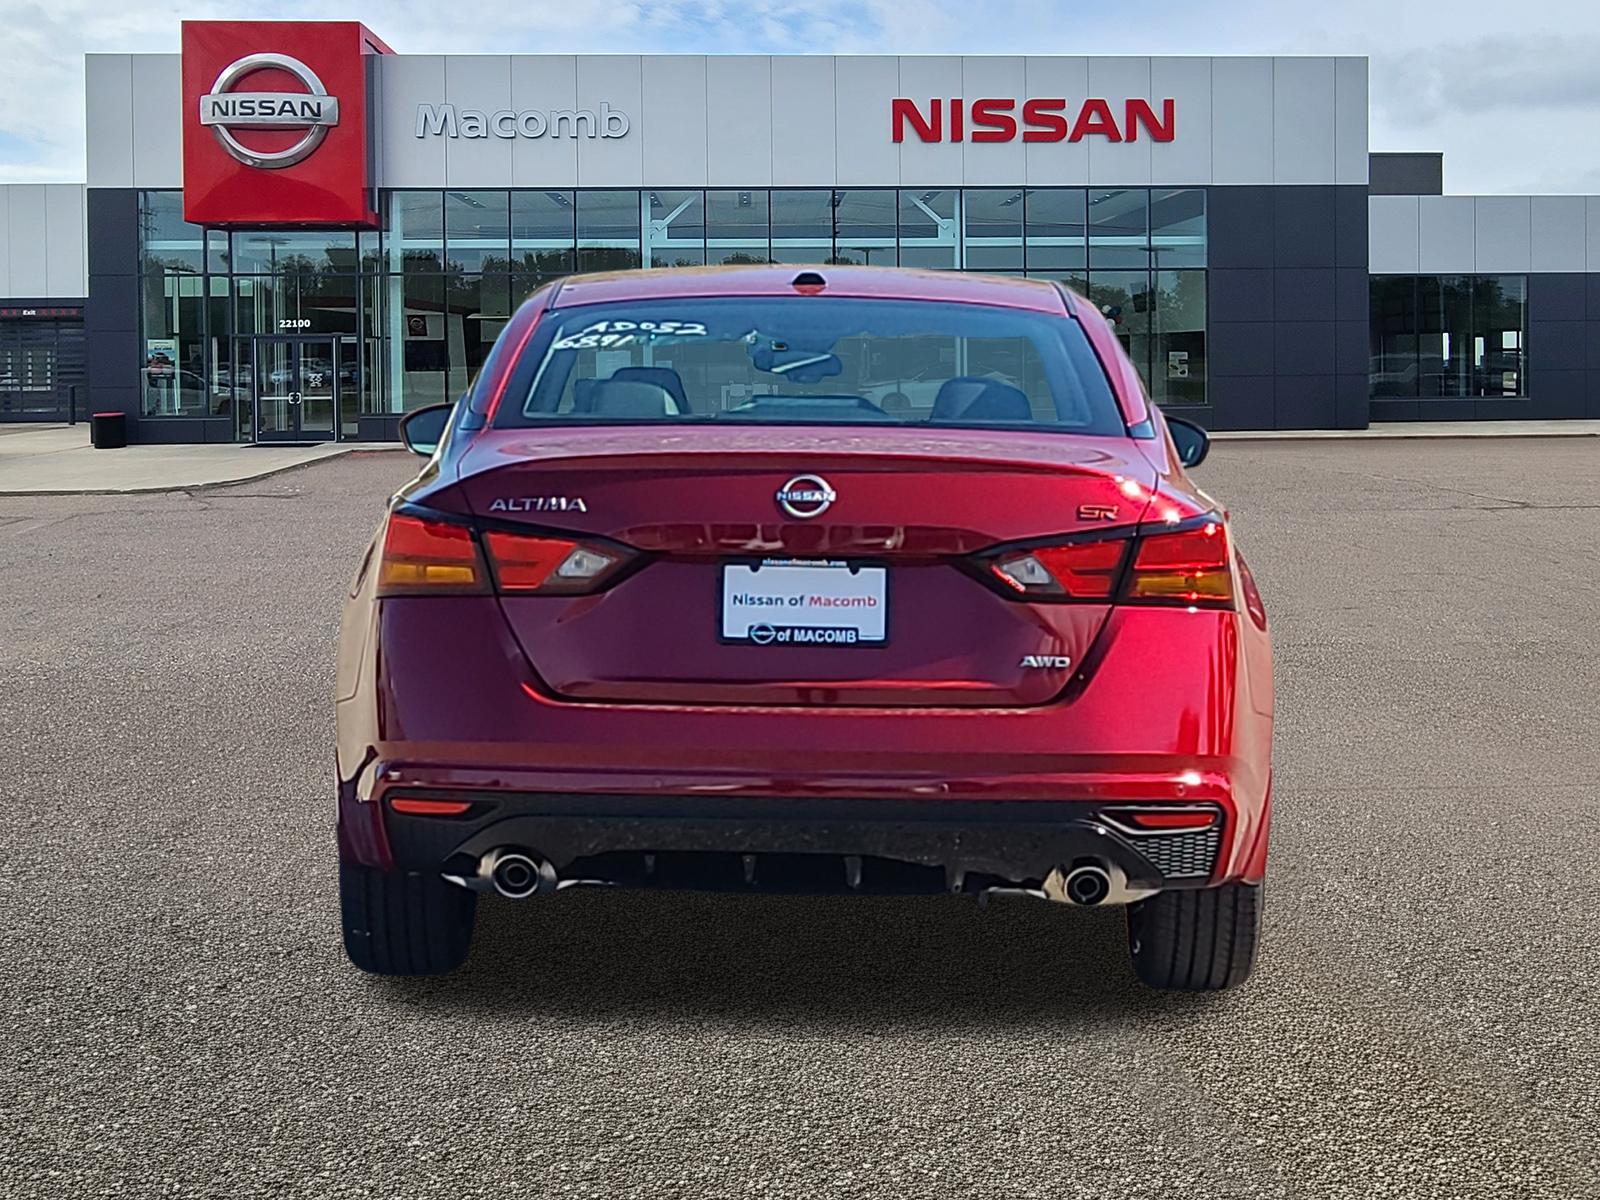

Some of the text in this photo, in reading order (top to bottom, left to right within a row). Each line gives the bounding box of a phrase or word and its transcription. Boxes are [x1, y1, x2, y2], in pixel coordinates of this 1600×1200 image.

[211, 98, 323, 119] NISSAN
[415, 101, 630, 139] Macomb
[891, 98, 1175, 143] NISSAN
[279, 319, 311, 328] 22100
[776, 490, 836, 502] NISSAN
[489, 497, 587, 512] ALTIMA
[1079, 504, 1118, 519] SR
[732, 592, 877, 607] Nissan of Macomb
[778, 629, 791, 641] of
[793, 629, 857, 643] MACOMB
[1020, 655, 1071, 668] AWD
